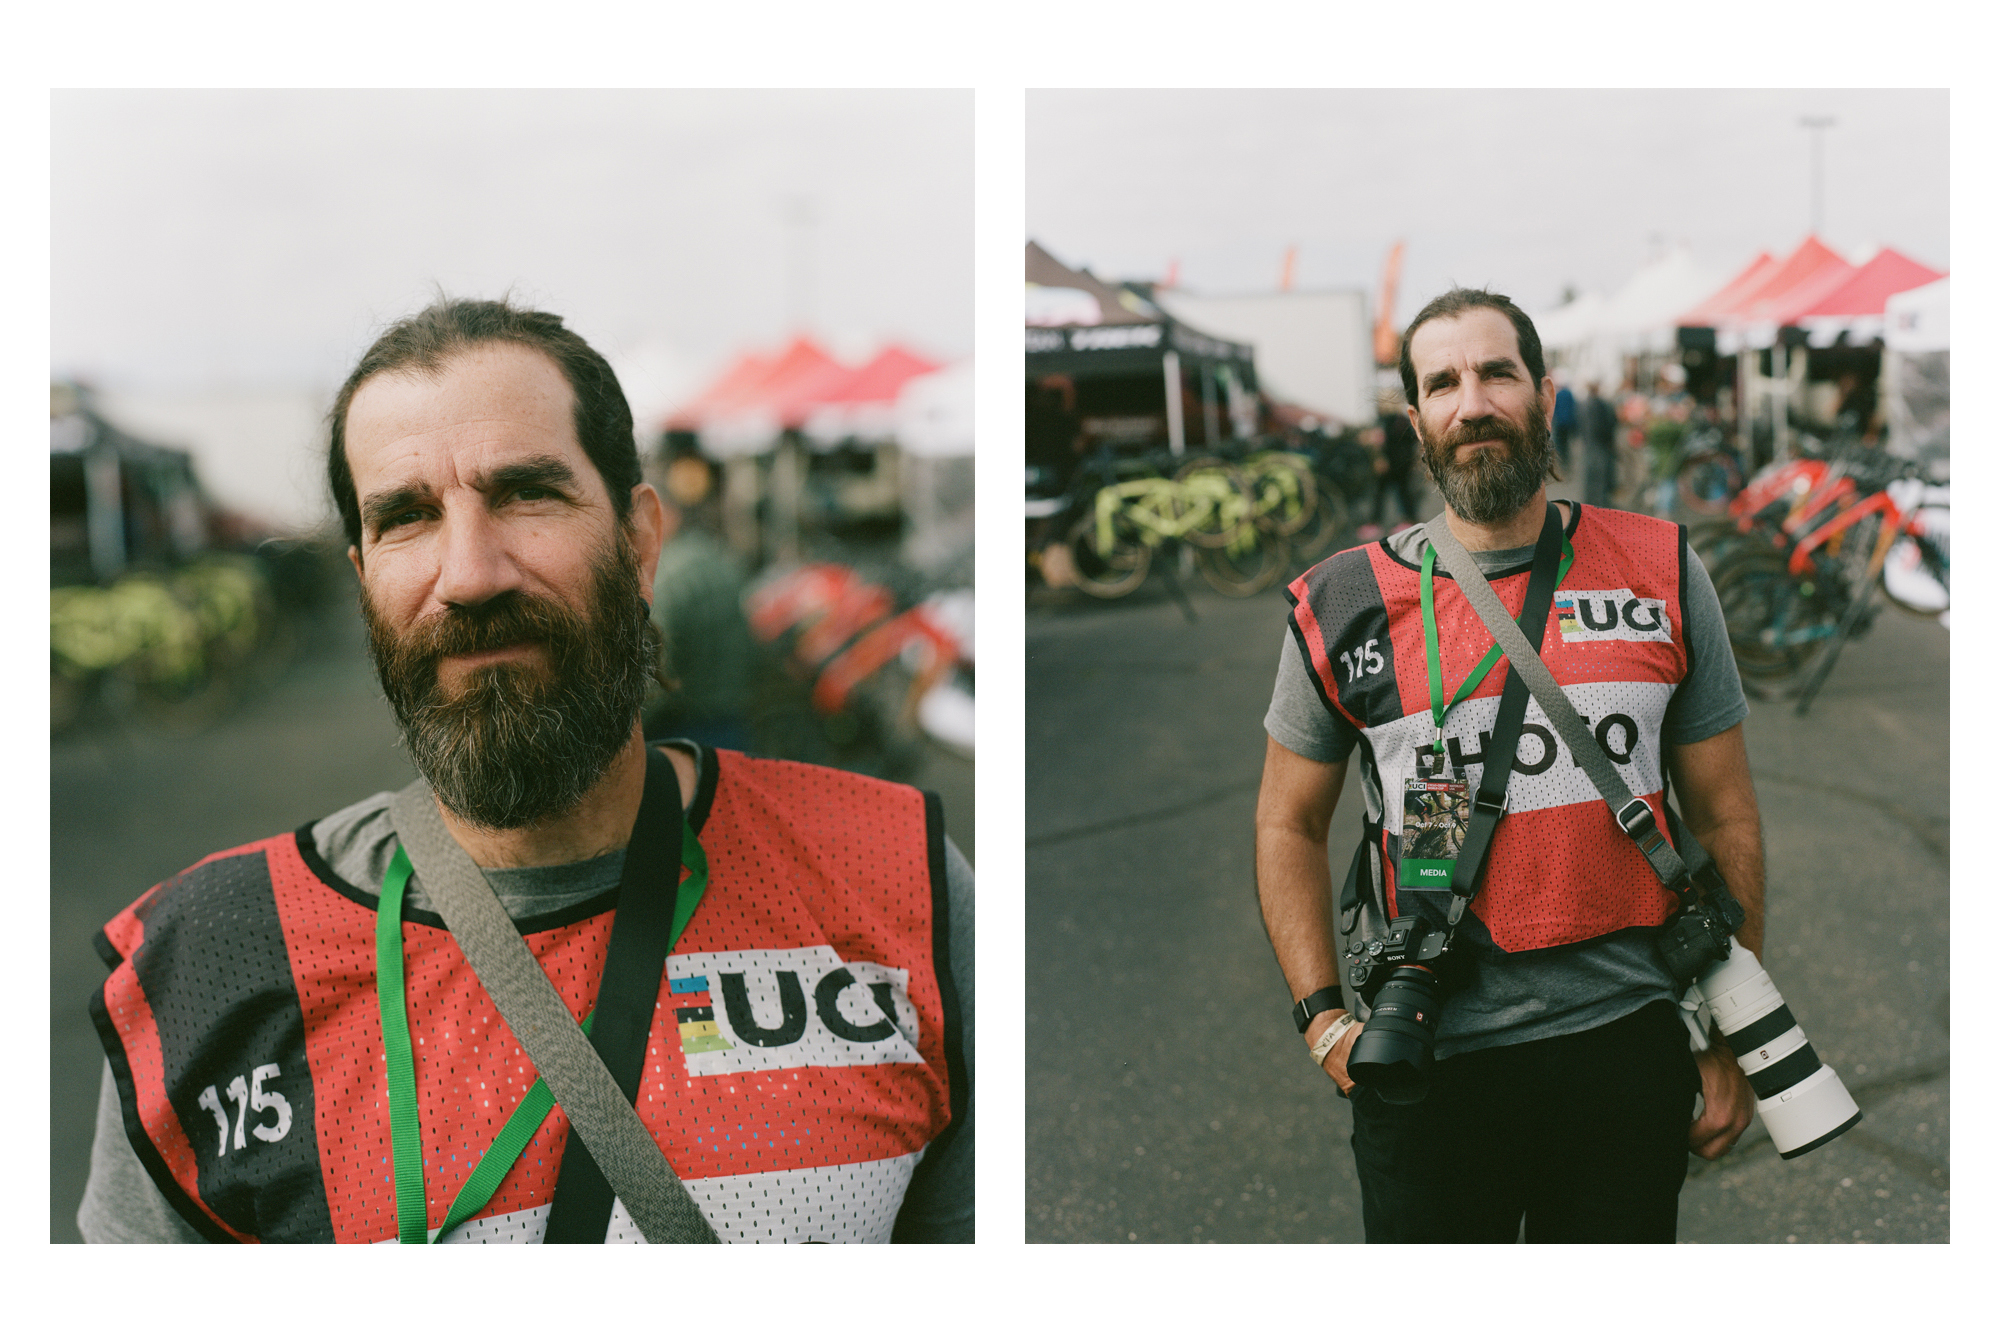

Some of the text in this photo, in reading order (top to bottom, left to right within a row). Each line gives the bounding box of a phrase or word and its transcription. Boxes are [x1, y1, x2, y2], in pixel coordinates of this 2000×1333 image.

[1339, 638, 1385, 684] 115
[1415, 713, 1639, 779] PHOO
[1420, 868, 1447, 877] MEDIA
[198, 1062, 293, 1158] 115
